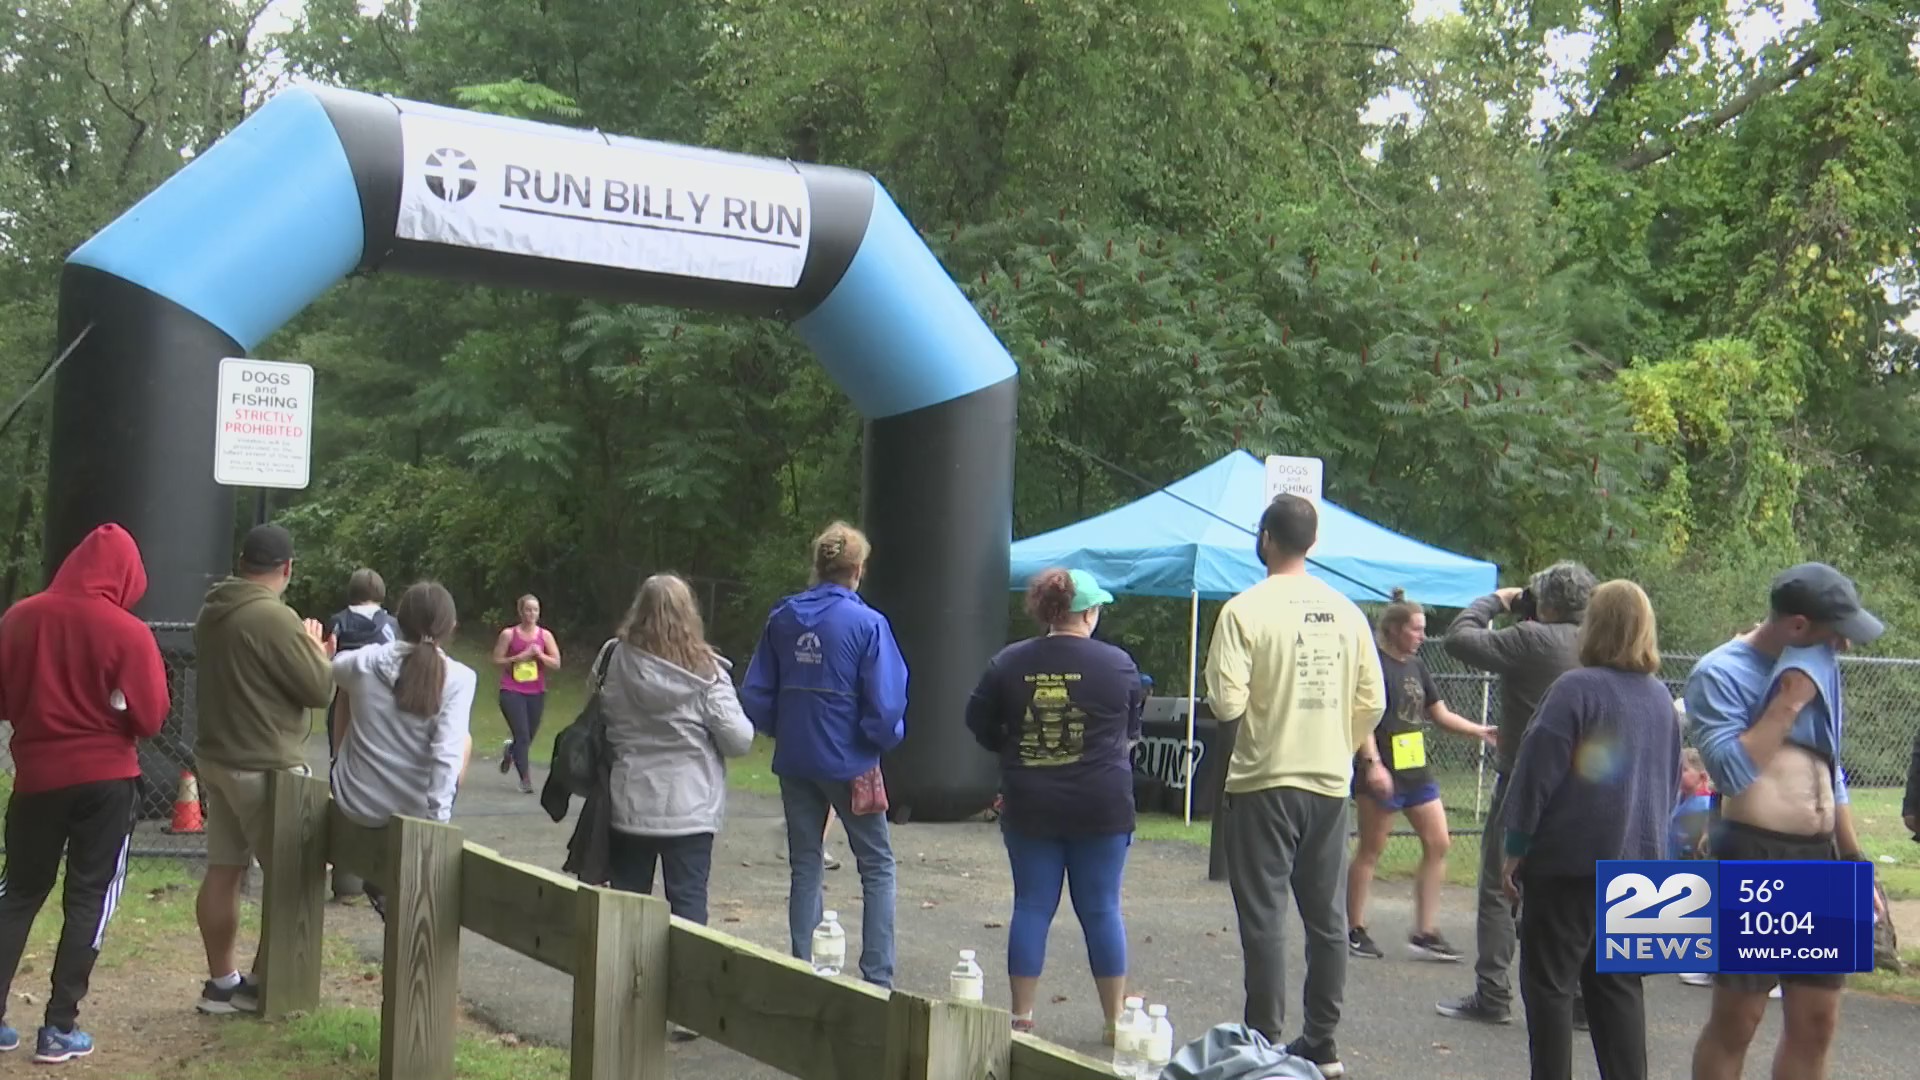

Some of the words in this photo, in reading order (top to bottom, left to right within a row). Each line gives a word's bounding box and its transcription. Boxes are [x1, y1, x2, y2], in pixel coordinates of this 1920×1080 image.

[505, 164, 592, 209] RUN
[603, 179, 711, 225] BILLY
[723, 197, 802, 239] RUN
[242, 370, 290, 385] DOGS
[254, 386, 278, 394] and
[232, 393, 298, 409] FISHING
[235, 409, 294, 423] STRICTLY
[225, 423, 303, 437] PROHIBITED
[1279, 464, 1308, 475] DOGS
[1273, 483, 1313, 494] FISHING
